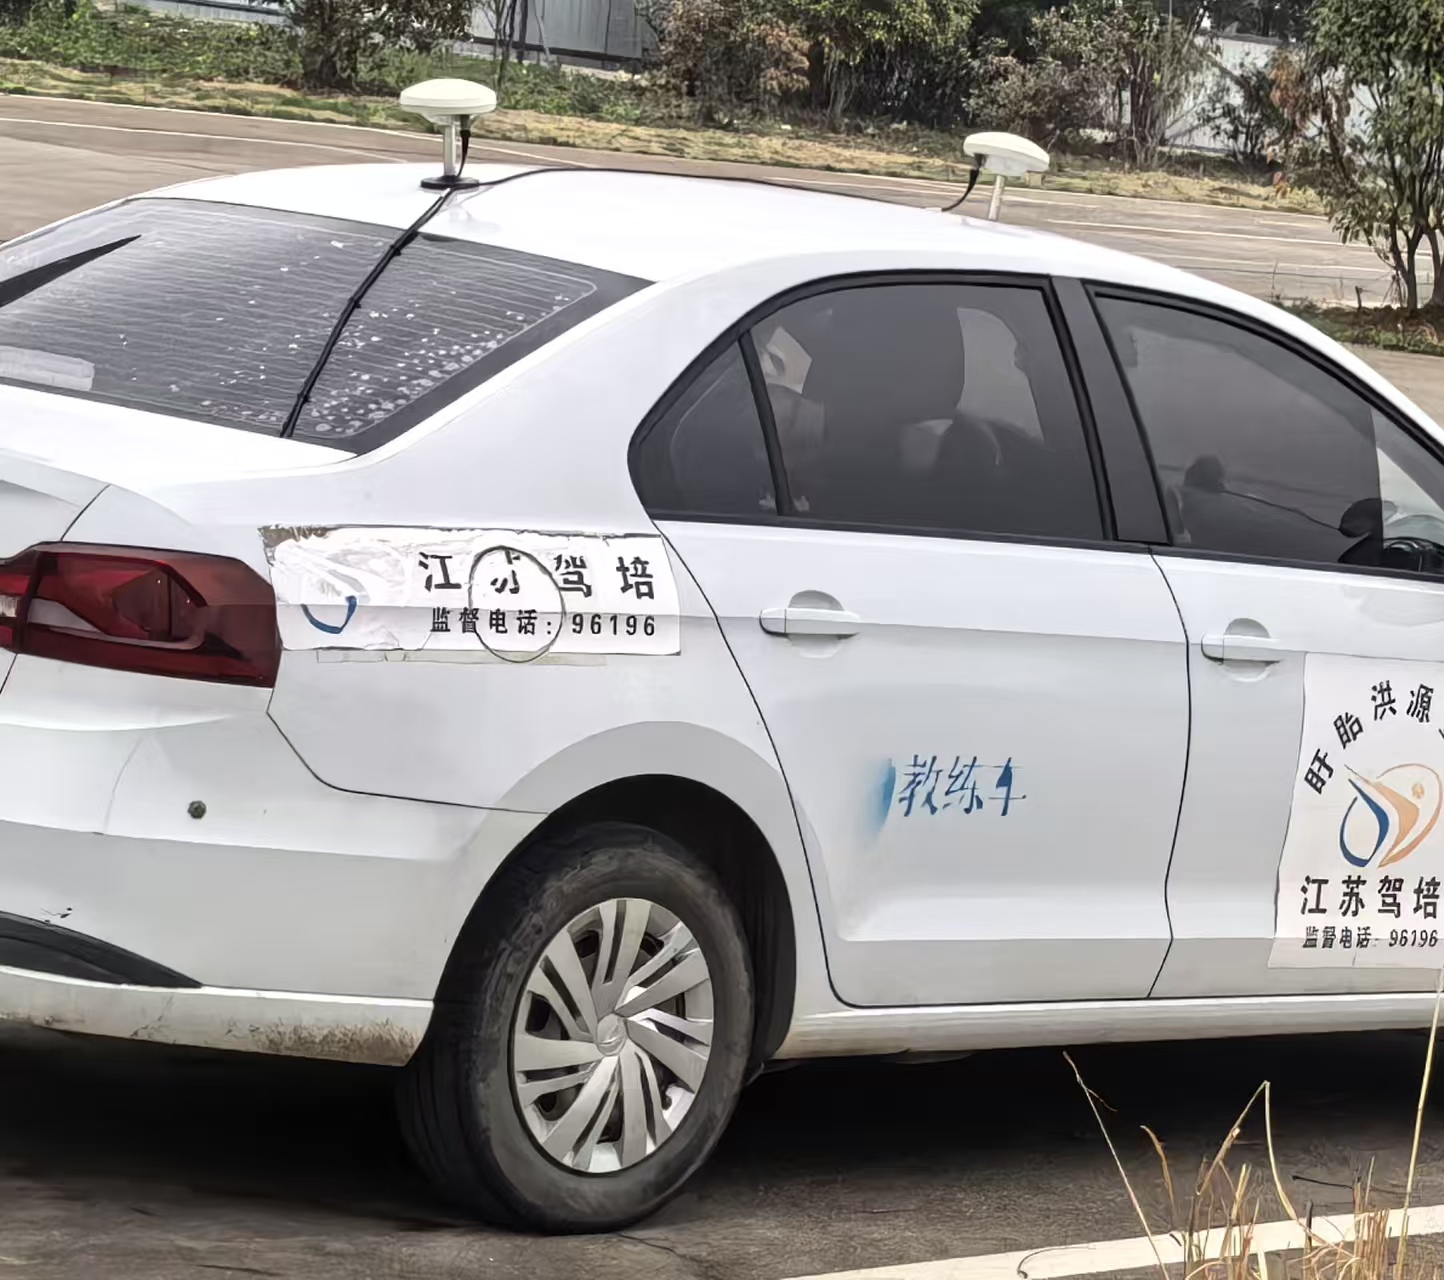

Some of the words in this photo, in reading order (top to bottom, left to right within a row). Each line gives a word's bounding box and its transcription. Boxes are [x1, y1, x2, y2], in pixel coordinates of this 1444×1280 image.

[898, 754, 1027, 817] 教练车
[1300, 874, 1441, 920] 江苏驾培
